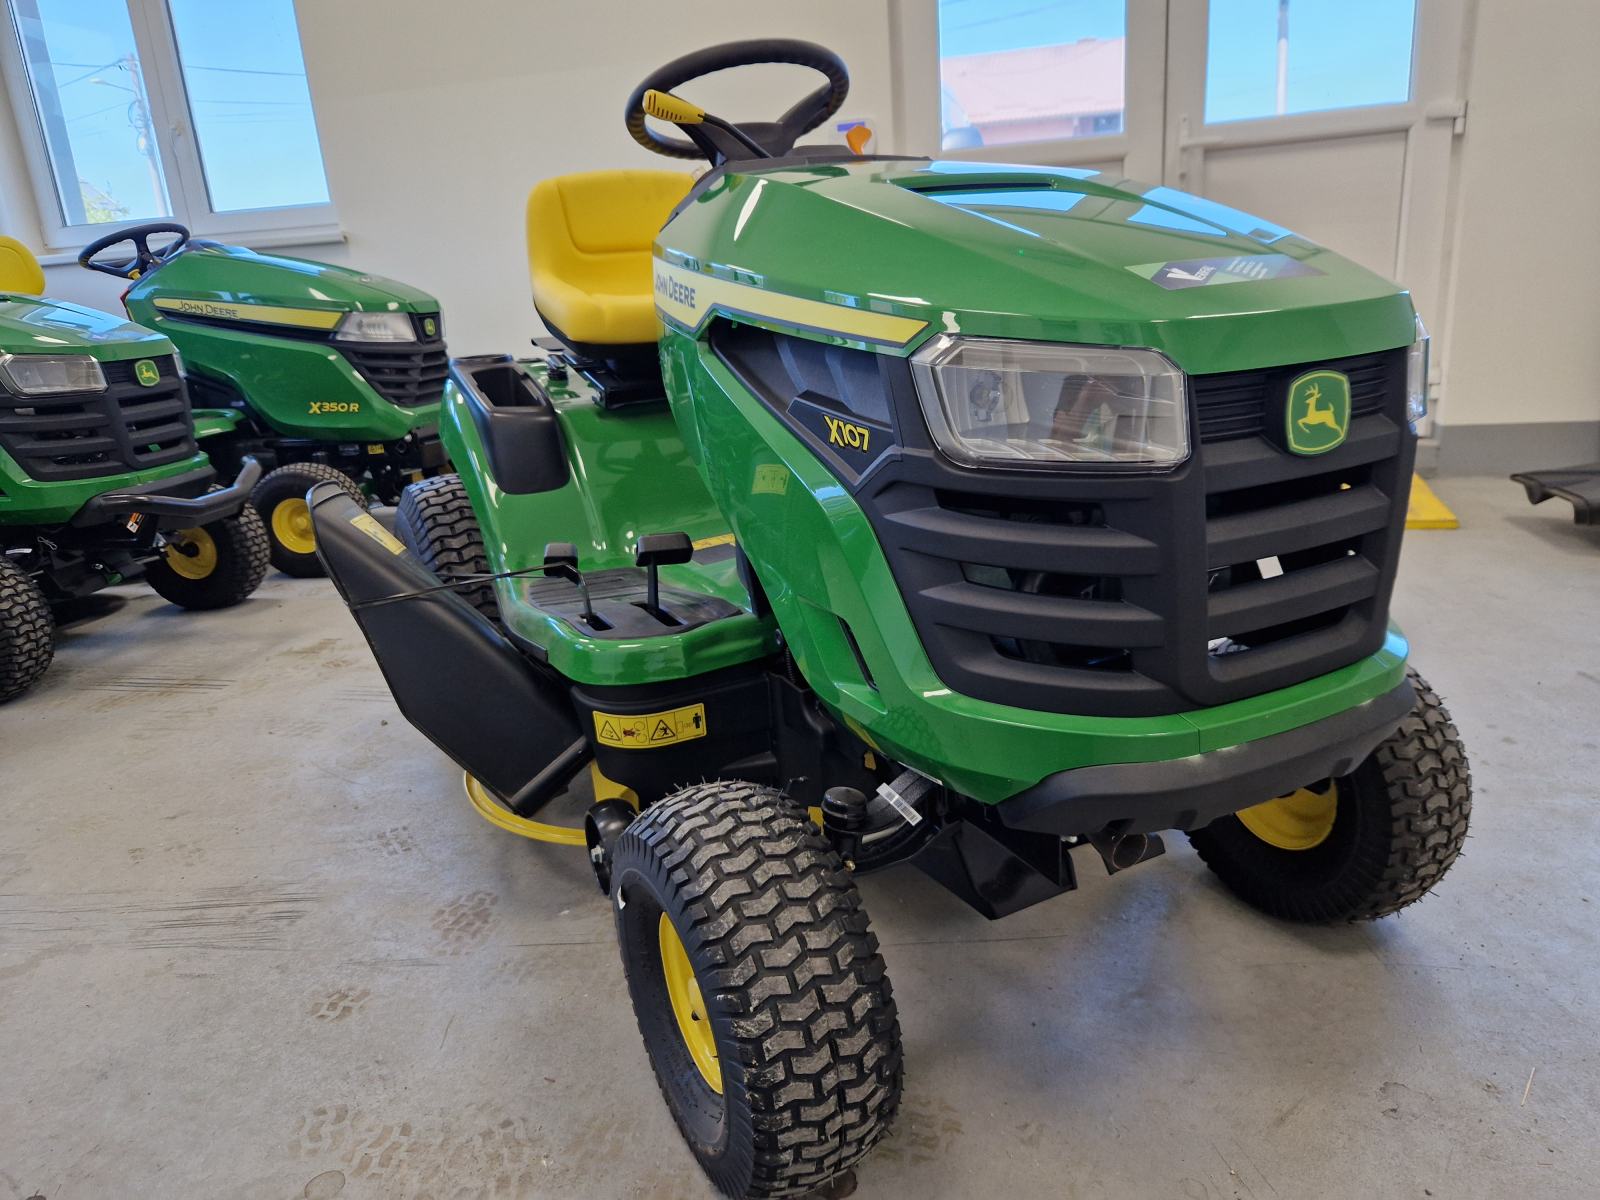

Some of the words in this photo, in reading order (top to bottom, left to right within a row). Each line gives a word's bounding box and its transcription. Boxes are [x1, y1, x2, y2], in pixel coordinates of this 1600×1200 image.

[669, 274, 696, 309] DEERE
[179, 300, 204, 313] JOHN
[205, 303, 239, 319] DEERE
[823, 414, 870, 453] X107
